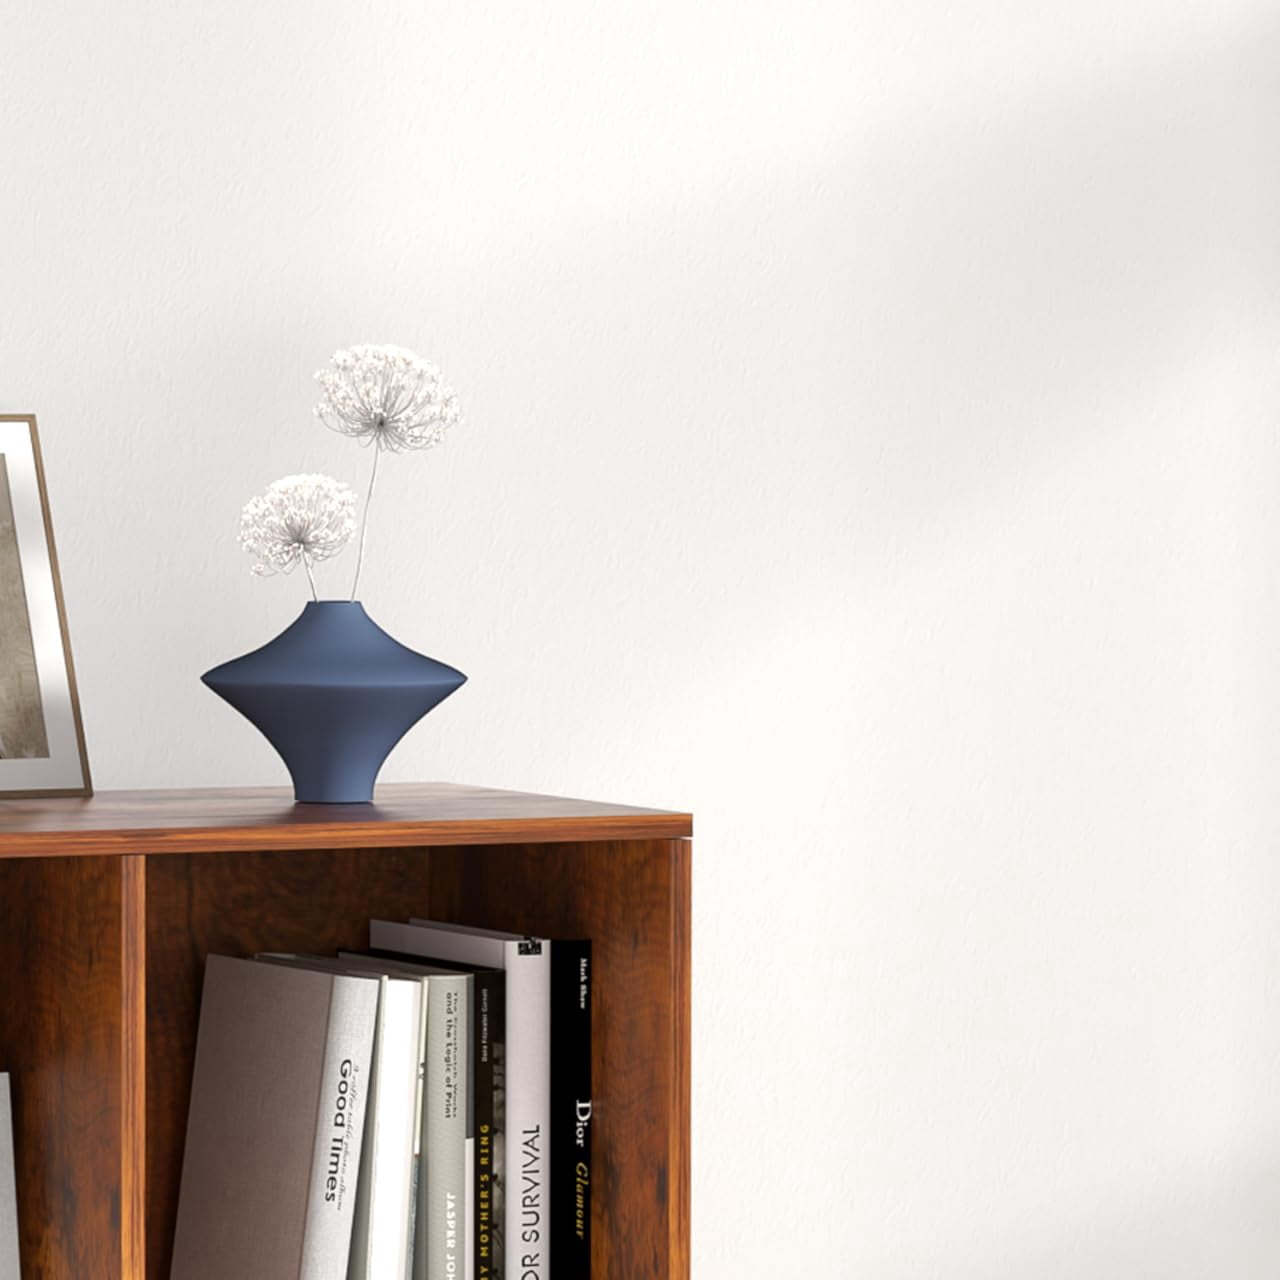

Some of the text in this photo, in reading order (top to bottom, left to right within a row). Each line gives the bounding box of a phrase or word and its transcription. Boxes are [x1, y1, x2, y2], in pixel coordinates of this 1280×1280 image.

[444, 992, 454, 1119] and the Logic of Print
[325, 1059, 353, 1202] Good Times
[480, 1124, 489, 1165] RING
[521, 1124, 540, 1243] SURVIVAL
[575, 1098, 592, 1239] Dior Glamour
[446, 1192, 457, 1250] JASPER
[480, 1174, 489, 1257] MOTHER'S
